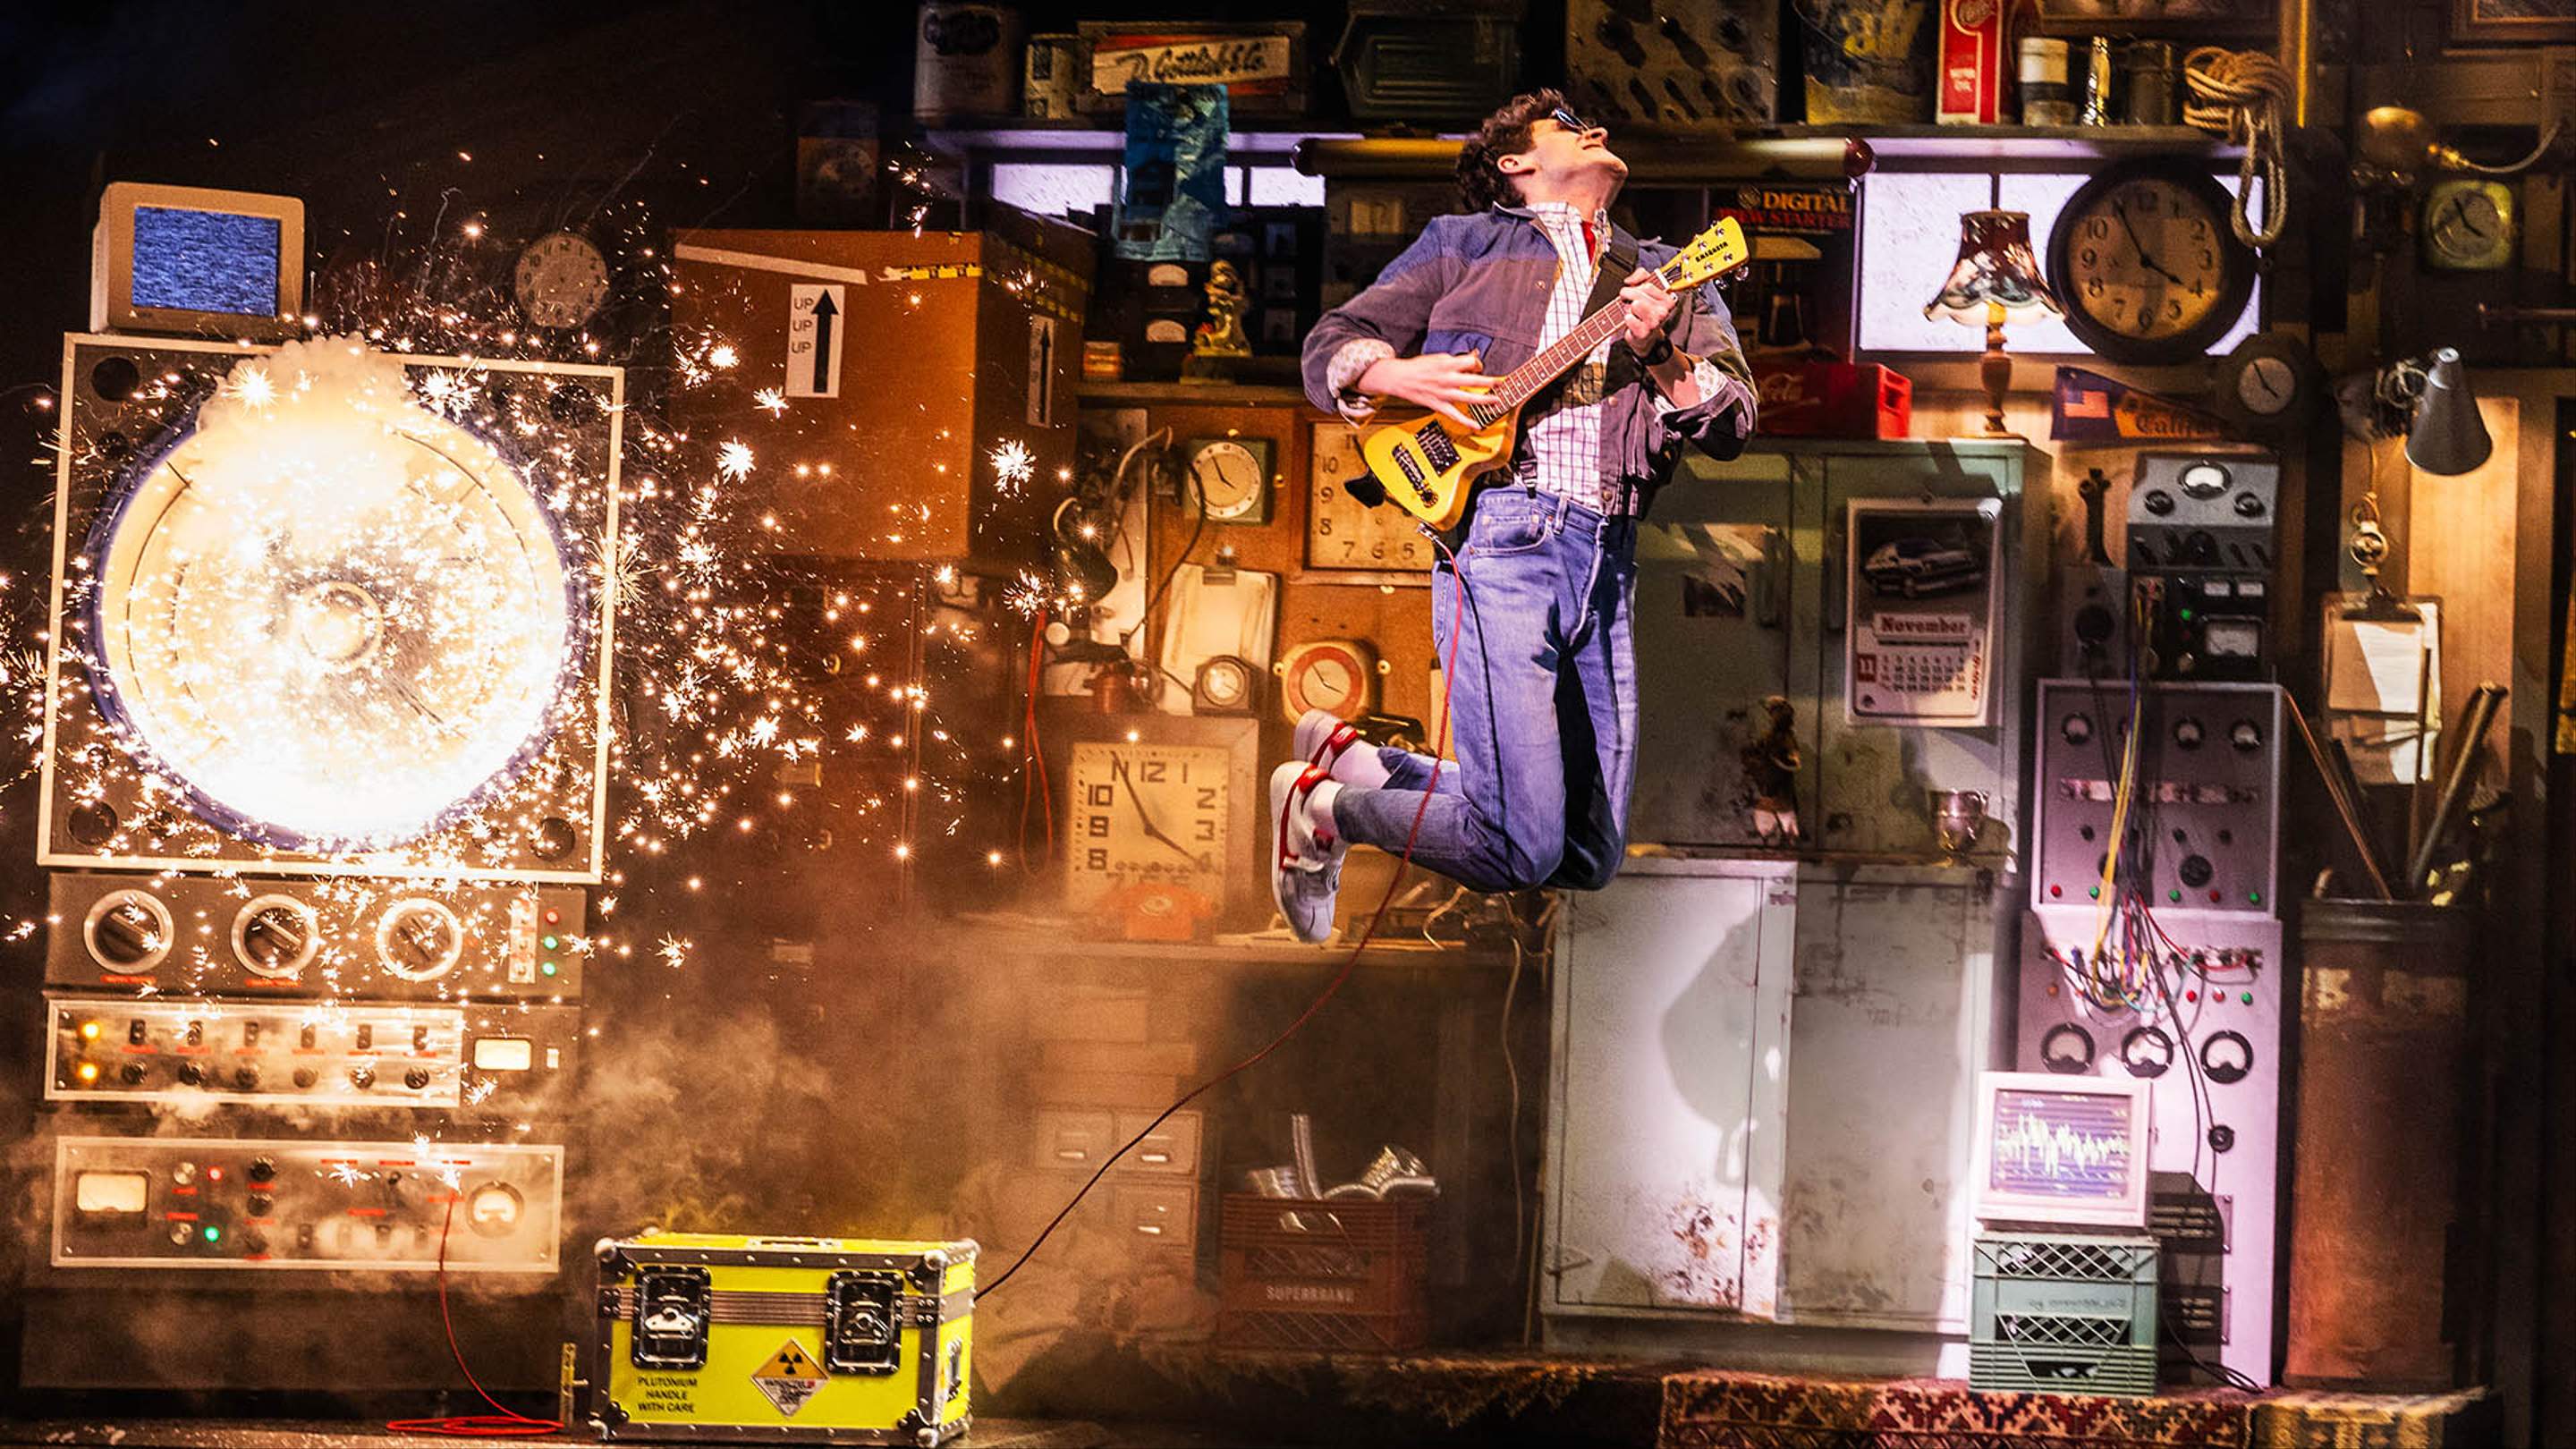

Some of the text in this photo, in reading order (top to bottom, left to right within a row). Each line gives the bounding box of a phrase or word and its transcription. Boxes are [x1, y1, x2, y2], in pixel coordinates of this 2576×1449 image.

[1763, 191, 1848, 213] DIGITAL
[1769, 210, 1852, 230] STARTER
[793, 296, 815, 310] UP
[792, 318, 813, 333] UP
[792, 341, 812, 354] UP
[1322, 456, 1339, 474] 10
[1320, 487, 1335, 504] 9
[1319, 518, 1333, 537] 8
[1343, 540, 1355, 558] 7
[1371, 541, 1385, 560] 6
[1402, 542, 1415, 560] 5
[1881, 617, 1967, 633] November
[1140, 761, 1166, 784] 12
[1088, 784, 1114, 807] 10
[1197, 787, 1216, 809] 2
[1089, 815, 1110, 837] 9
[1195, 819, 1216, 842] 3
[1088, 849, 1108, 871] 8
[1266, 1285, 1355, 1303] SUPERBRAND
[638, 1377, 698, 1387] PLUTONIUM
[646, 1390, 687, 1401] HANDLE
[637, 1402, 696, 1414] WITH CARE
